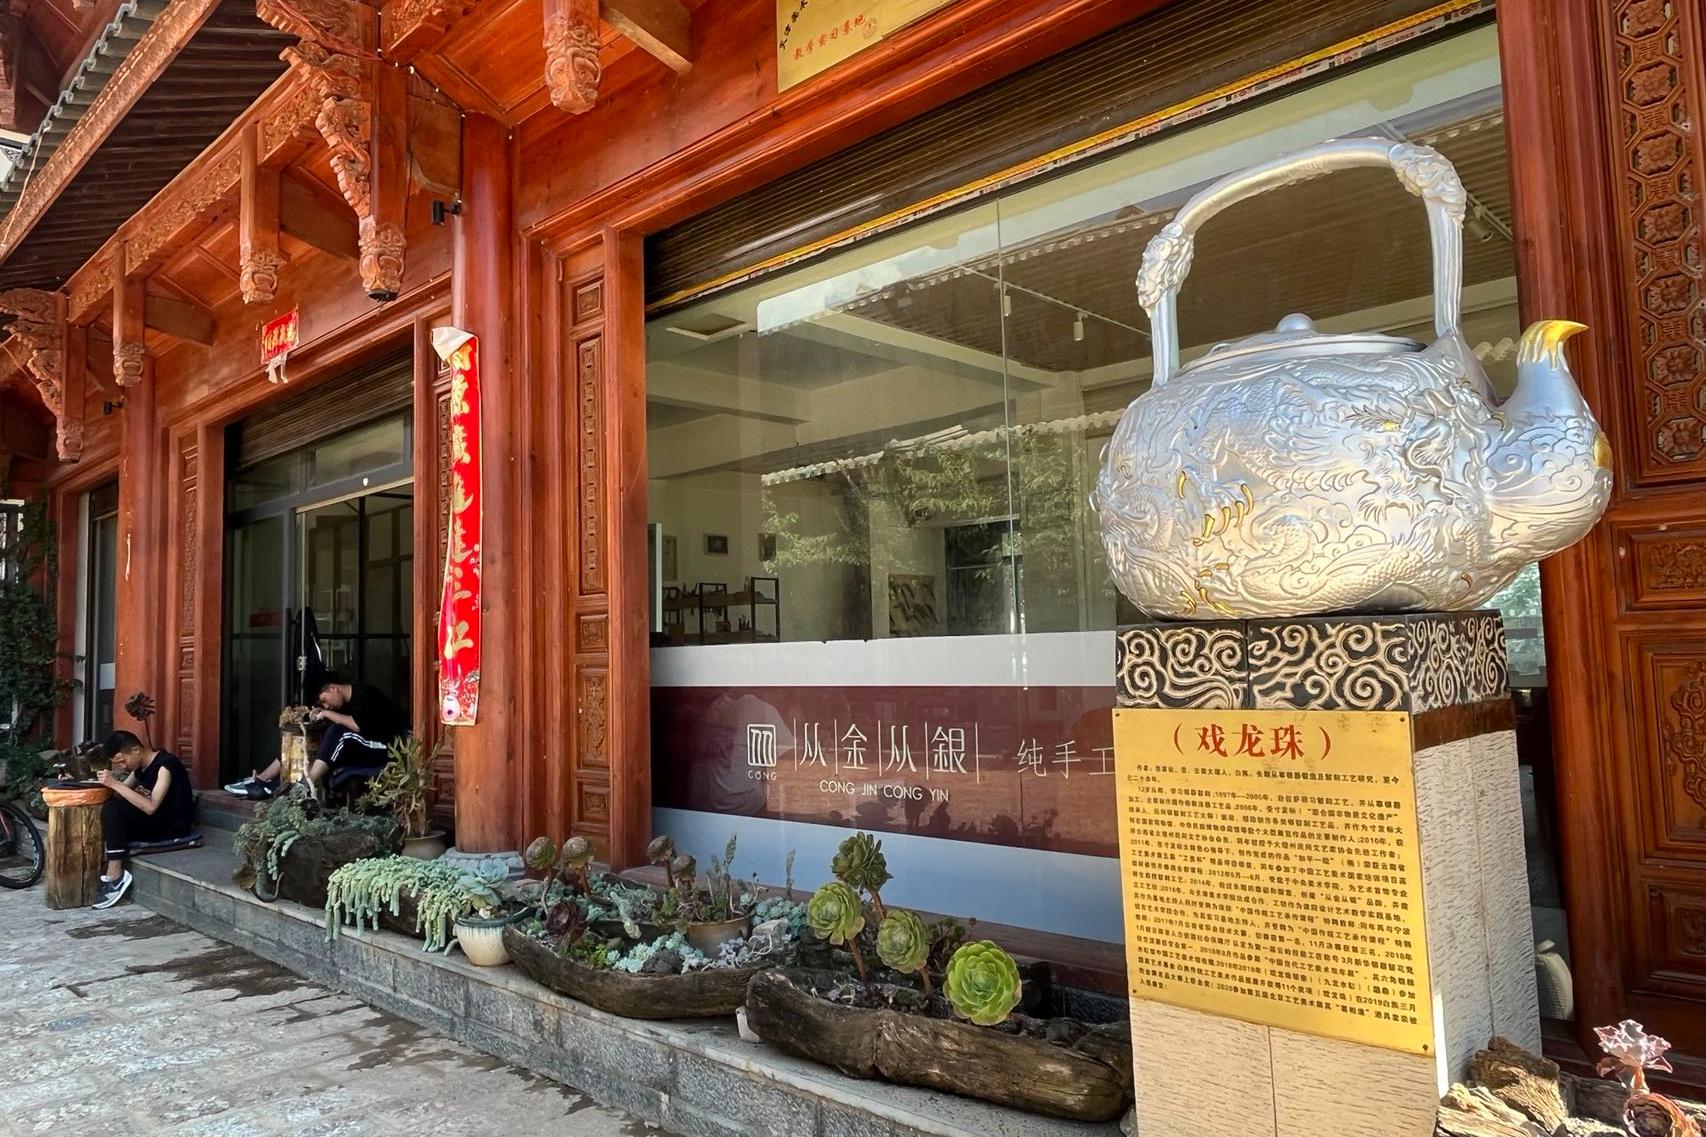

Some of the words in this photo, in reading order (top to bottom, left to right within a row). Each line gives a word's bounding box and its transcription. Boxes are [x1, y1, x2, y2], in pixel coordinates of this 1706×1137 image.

[1017, 738, 1115, 779] 纯手工
[747, 771, 777, 781] CONG
[819, 780, 855, 795] CONG
[861, 783, 878, 796] JIN
[883, 785, 923, 800] CONG
[929, 788, 949, 802] YIN
